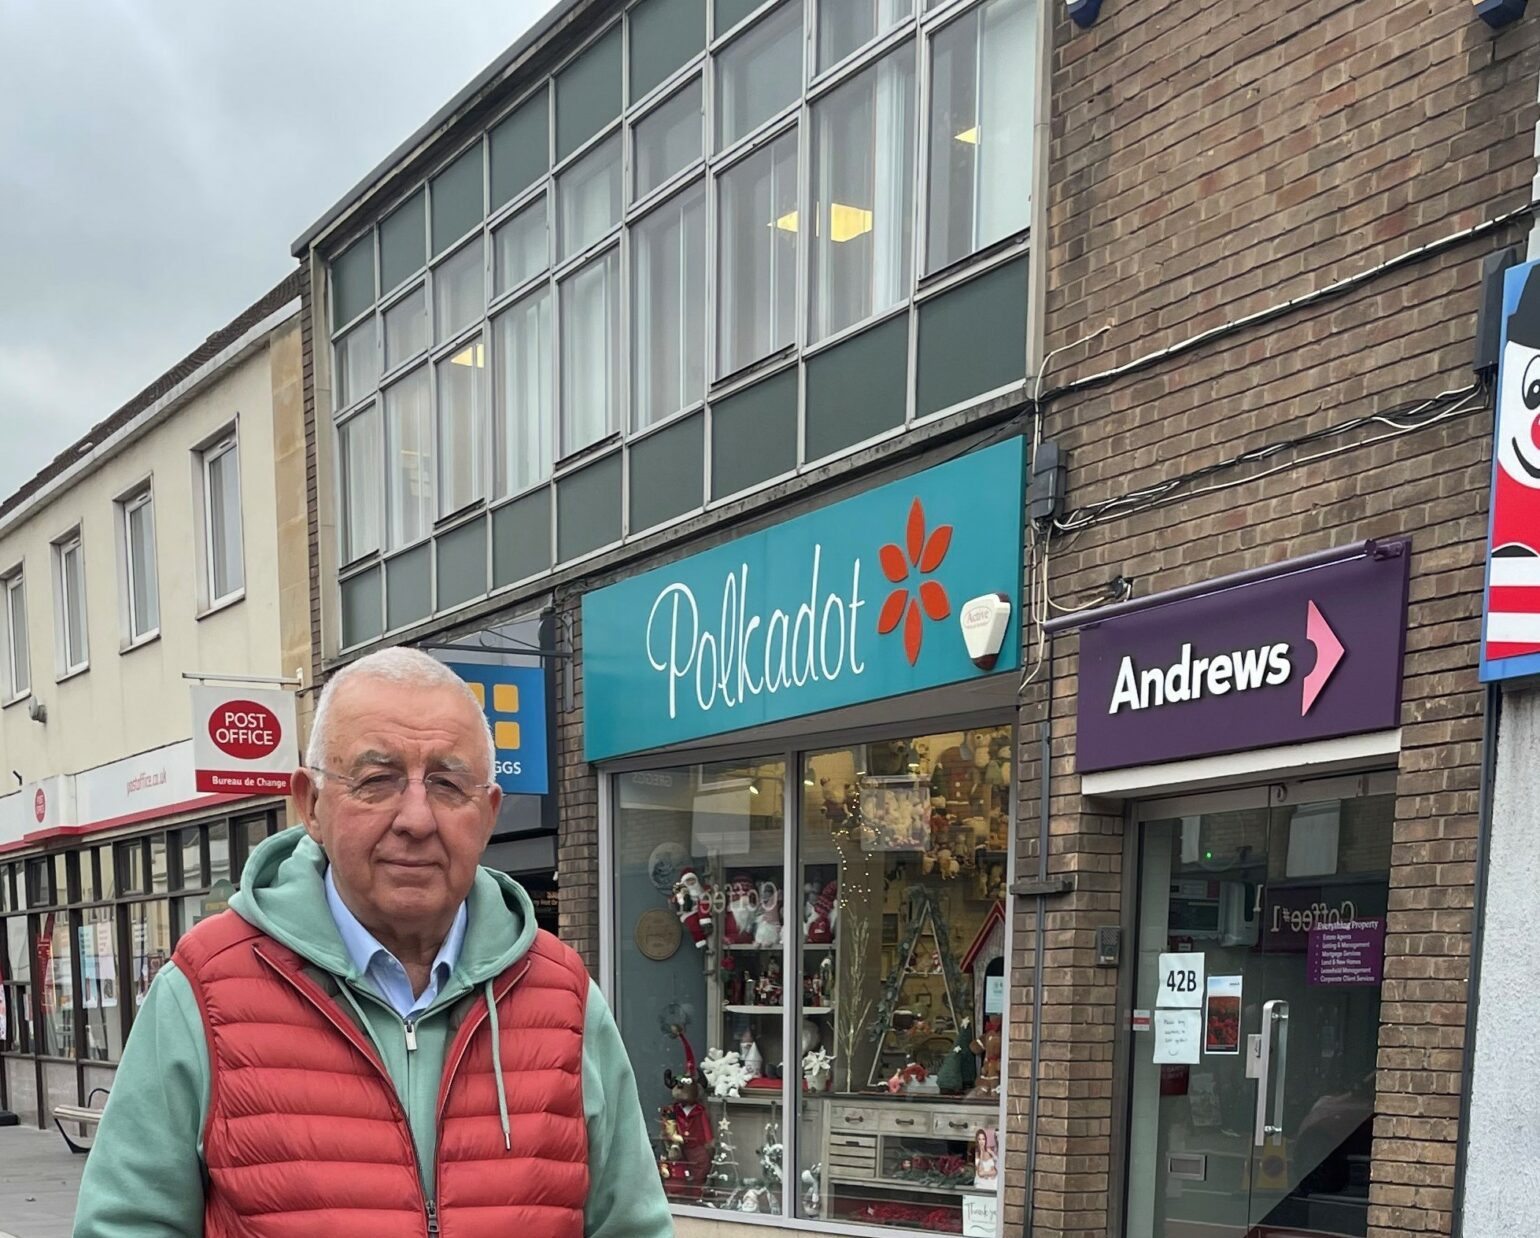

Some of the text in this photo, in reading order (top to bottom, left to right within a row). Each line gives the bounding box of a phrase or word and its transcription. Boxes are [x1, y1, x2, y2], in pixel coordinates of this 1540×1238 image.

[646, 544, 865, 719] Polkadot
[1109, 643, 1291, 714] Andrews
[225, 712, 266, 728] POST
[216, 728, 274, 745] OFFICE
[496, 761, 522, 775] GGS
[127, 768, 167, 798] postoffice.co.uk
[212, 775, 287, 789] Bureau de Change
[1317, 920, 1379, 931] Everything Property
[1166, 970, 1197, 992] 42B
